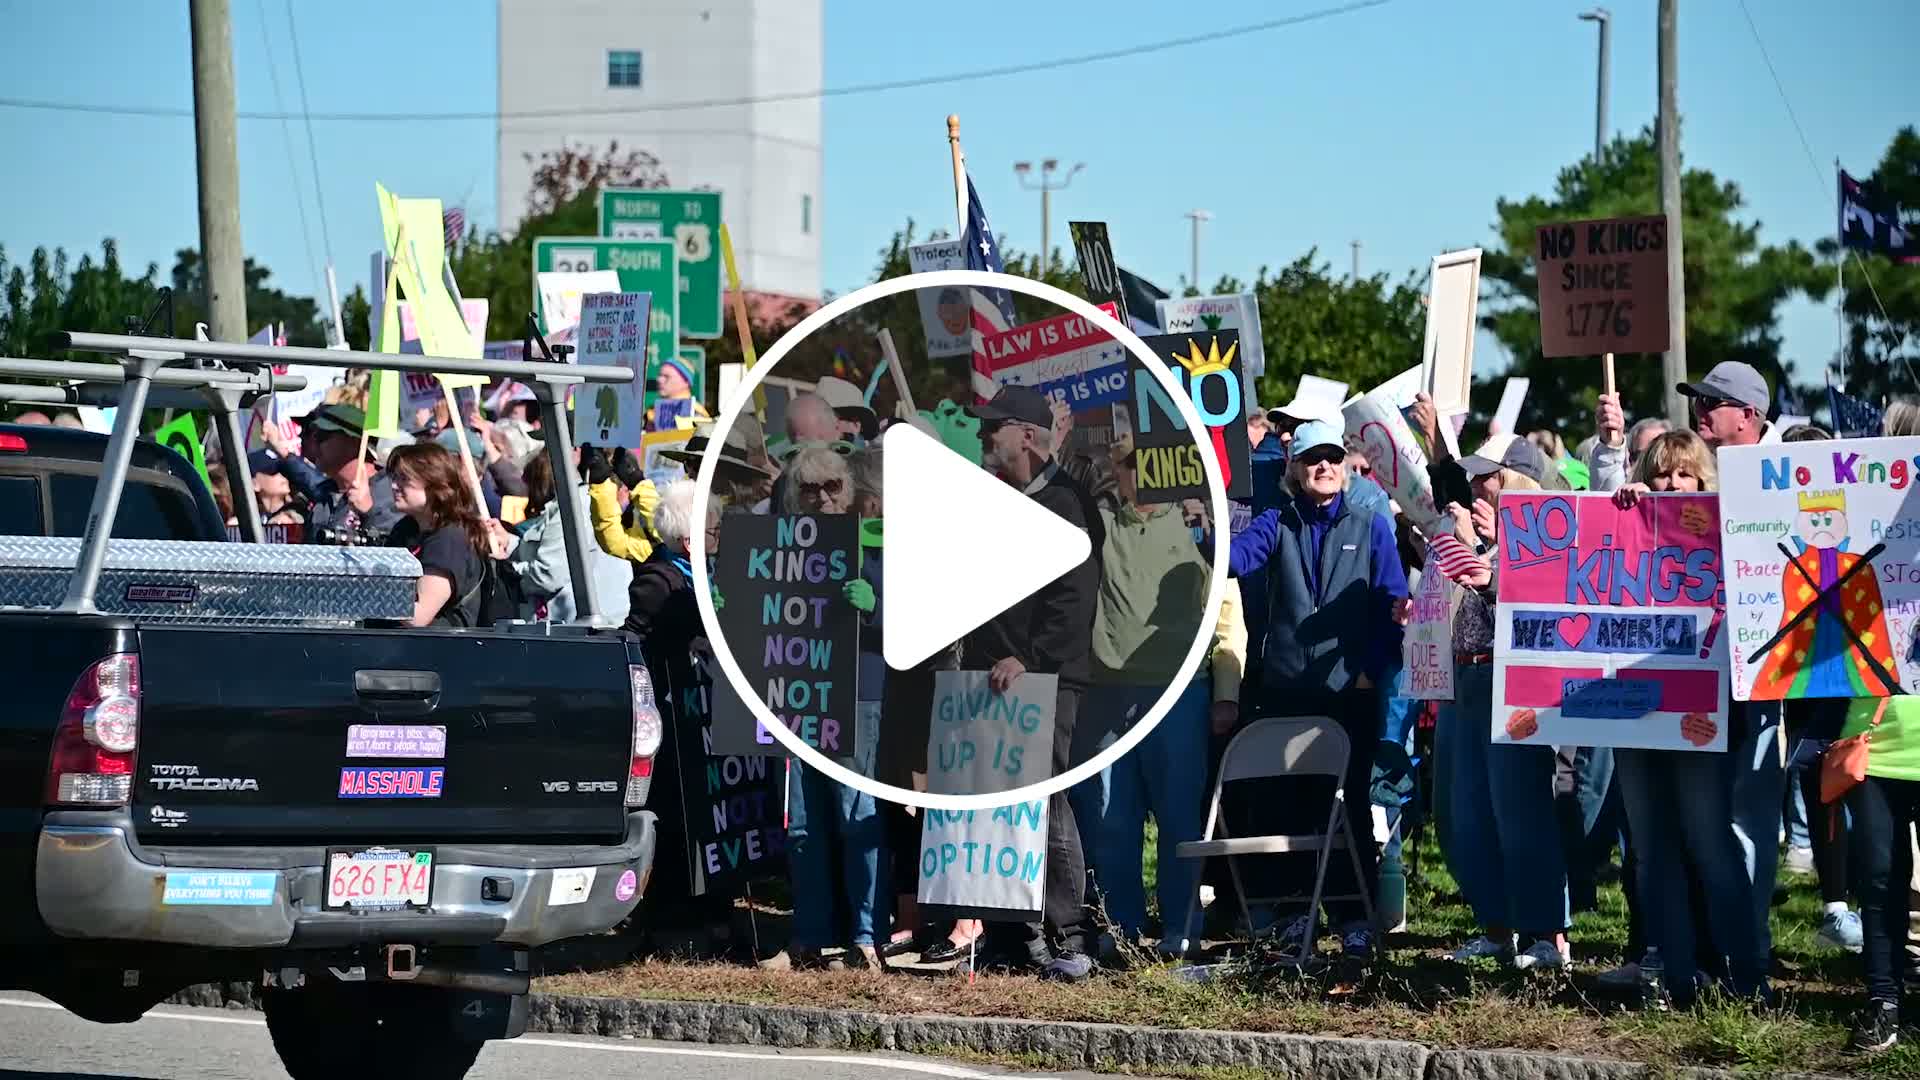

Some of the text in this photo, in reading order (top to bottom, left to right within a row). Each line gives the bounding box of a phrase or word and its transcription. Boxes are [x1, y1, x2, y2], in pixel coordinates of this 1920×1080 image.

[684, 201, 702, 219] TO
[685, 232, 699, 254] 6
[1541, 222, 1664, 260] NO KINGS
[608, 247, 662, 270] SOUTH
[1082, 241, 1113, 294] NO
[1561, 262, 1633, 290] SINCE
[595, 311, 620, 325] PROTECT
[623, 310, 635, 322] OUR
[1565, 301, 1635, 337] 1776
[988, 330, 1033, 360] LAW
[1039, 325, 1060, 346] IS
[1071, 383, 1091, 401] IS
[1134, 366, 1241, 432] NO
[1136, 444, 1204, 489] KINGS
[1761, 456, 1811, 490] No
[777, 516, 817, 548] NO
[1500, 497, 1577, 561] NO
[1725, 518, 1791, 538] Community
[748, 549, 848, 583] KINGS
[1735, 560, 1781, 579] Peace
[762, 592, 828, 628] NOT
[1751, 610, 1764, 622] by
[1513, 618, 1556, 648] WE
[1738, 627, 1770, 642] Ben
[764, 633, 832, 671] NOW
[1411, 643, 1438, 668] DUE
[767, 677, 833, 712] NOT
[1411, 670, 1449, 691] PROCESS
[938, 690, 1041, 735] GIVING
[151, 764, 200, 776] TOYOTA
[938, 739, 1024, 775] UP IS
[149, 777, 260, 791] TACOMA
[340, 770, 443, 795] MASSHOLE
[542, 781, 570, 792] V6
[706, 755, 766, 794] NOW
[991, 801, 1042, 831] AN
[416, 855, 428, 863] 27
[922, 842, 1043, 883] OPTION
[332, 864, 427, 897] 626 FX4
